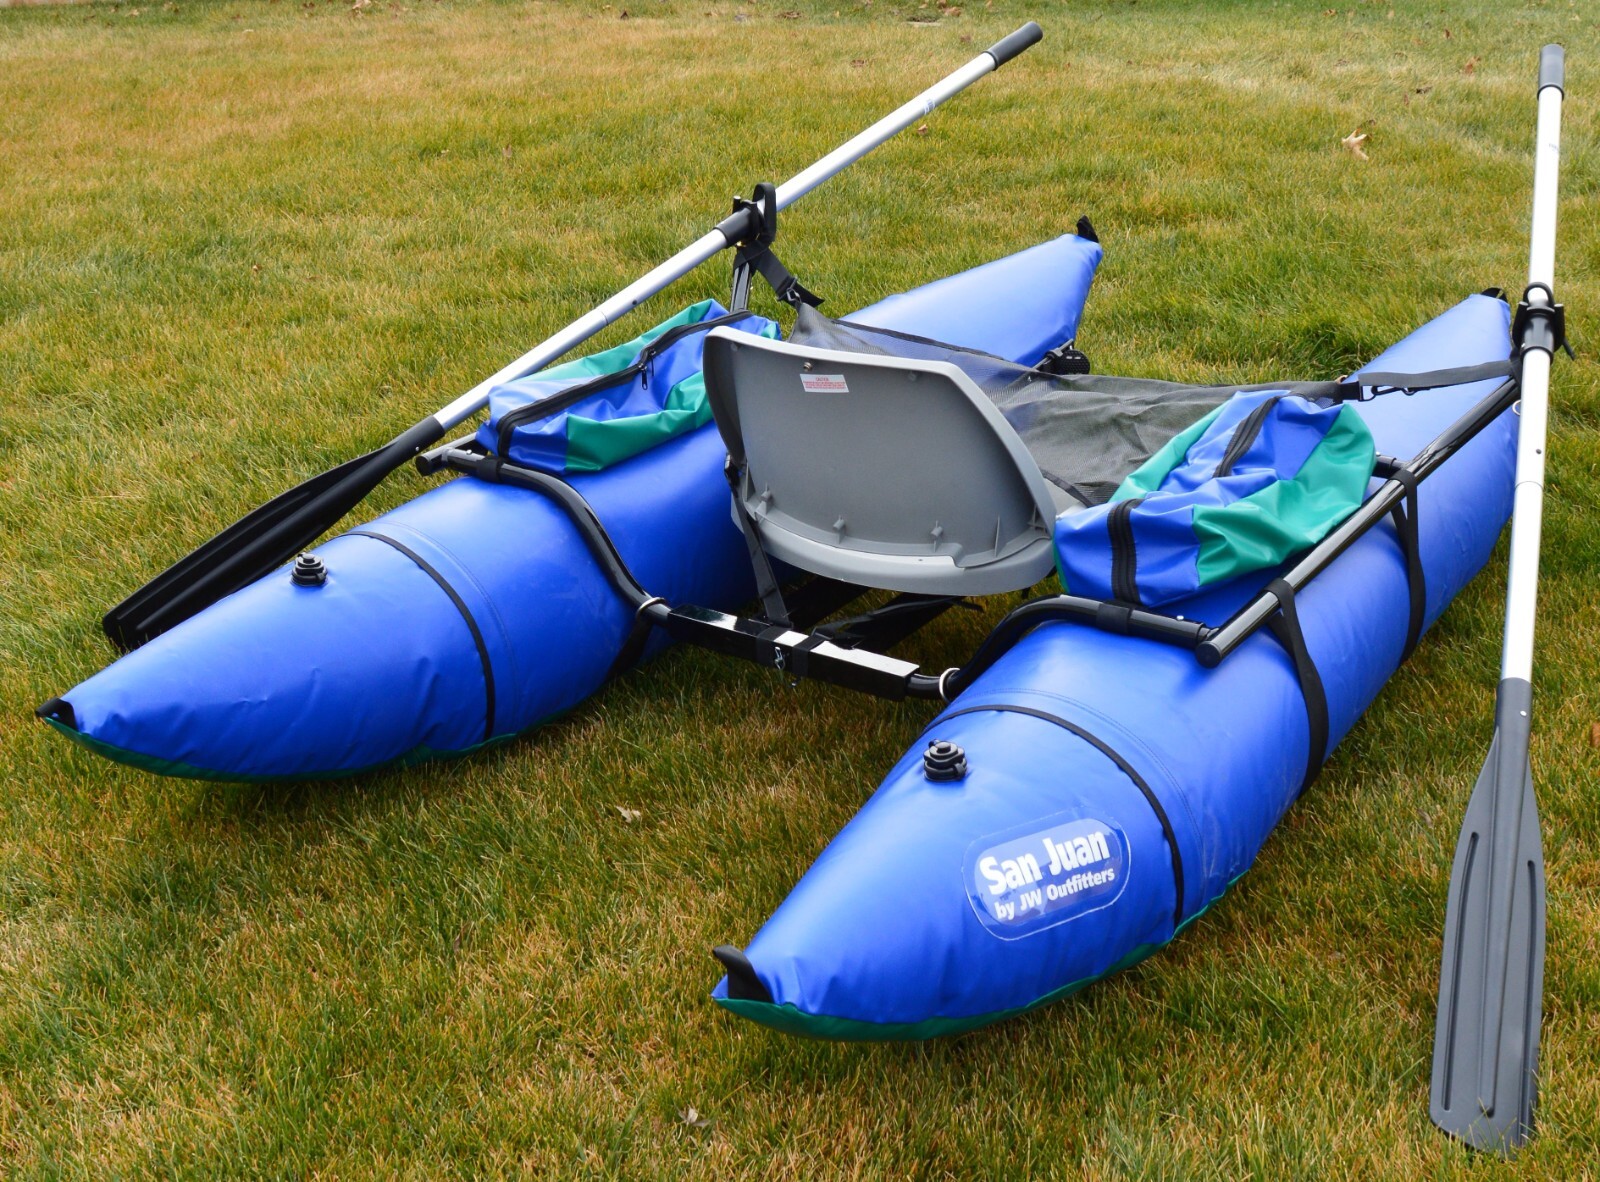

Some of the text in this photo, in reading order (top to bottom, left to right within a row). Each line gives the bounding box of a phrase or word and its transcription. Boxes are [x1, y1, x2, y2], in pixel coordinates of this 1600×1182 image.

[979, 831, 1110, 895] San Juan
[994, 868, 1115, 920] by JW Outfitters
